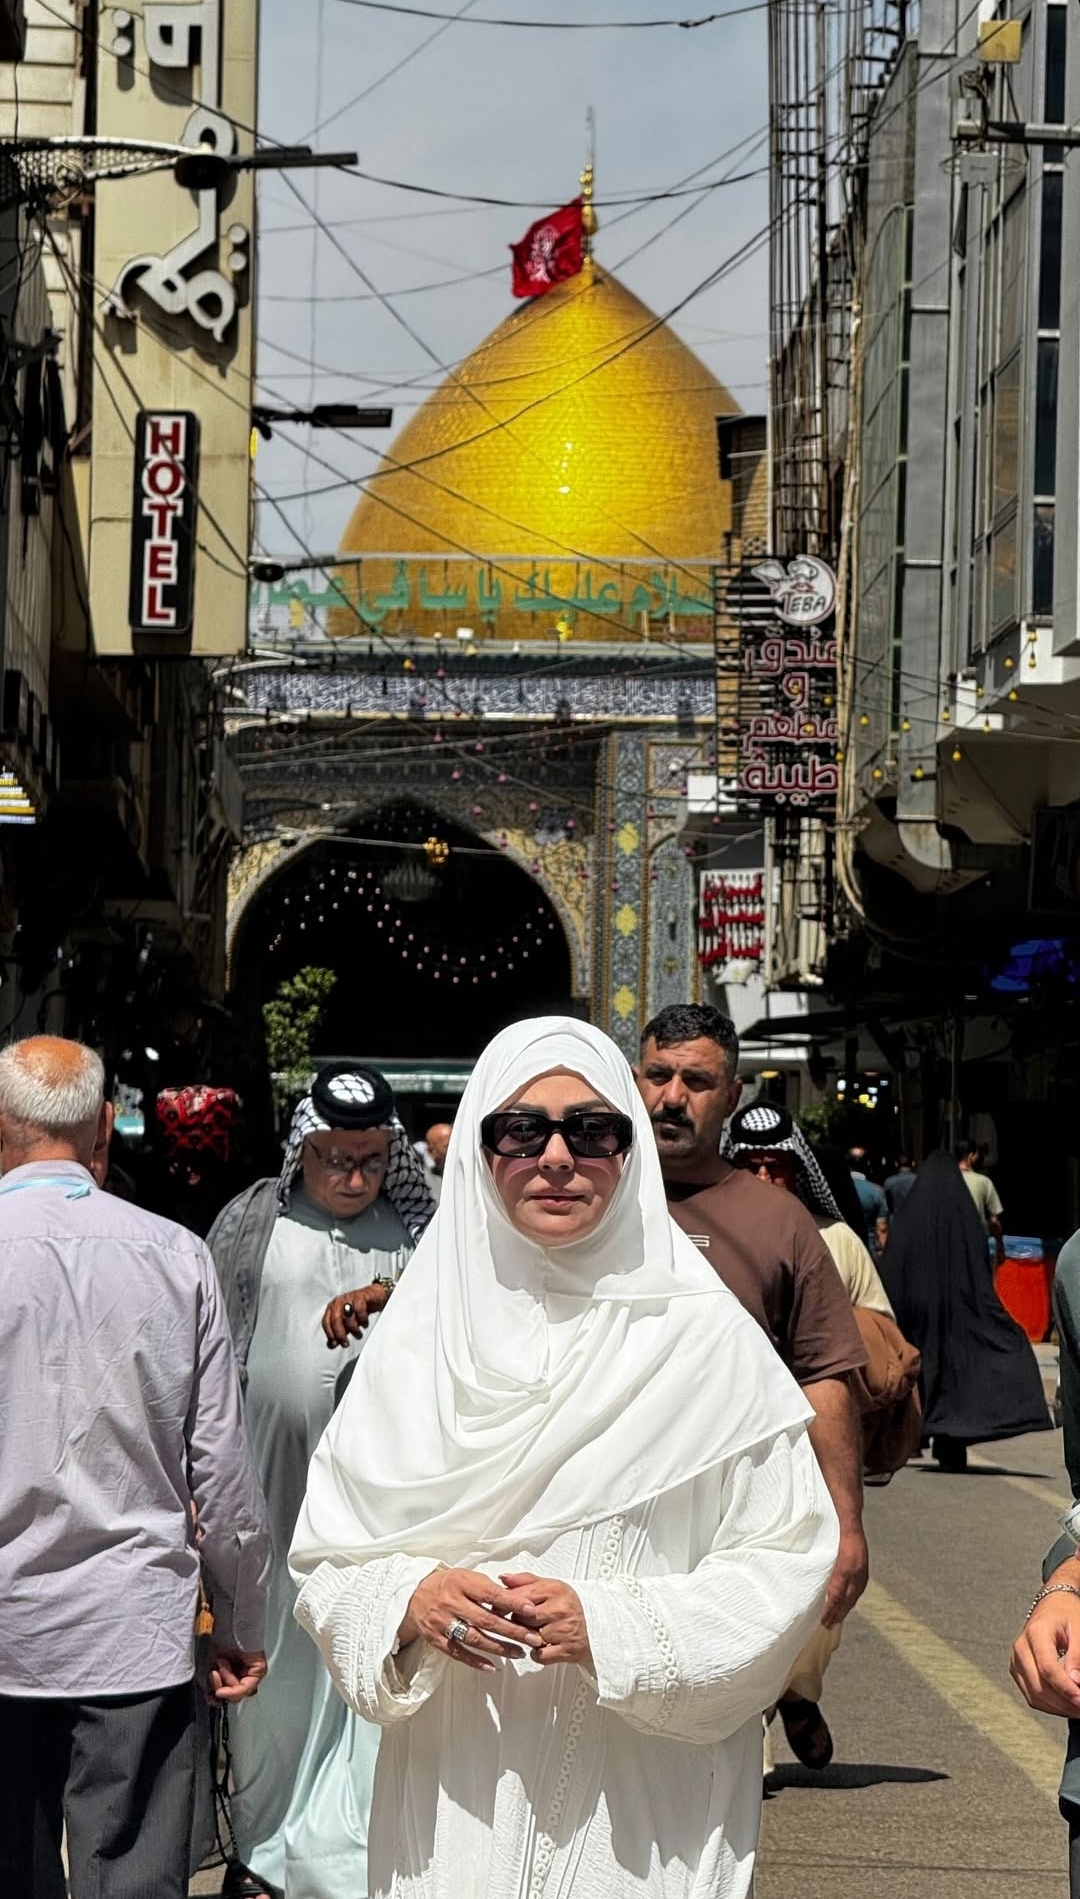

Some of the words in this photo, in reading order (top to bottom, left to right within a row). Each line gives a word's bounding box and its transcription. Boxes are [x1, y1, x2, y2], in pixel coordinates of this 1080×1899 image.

[142, 416, 186, 626] HOTEL
[476, 566, 503, 624] يا
[780, 590, 827, 616] TEBA
[782, 671, 810, 710] و
[742, 750, 838, 805] طيبة
